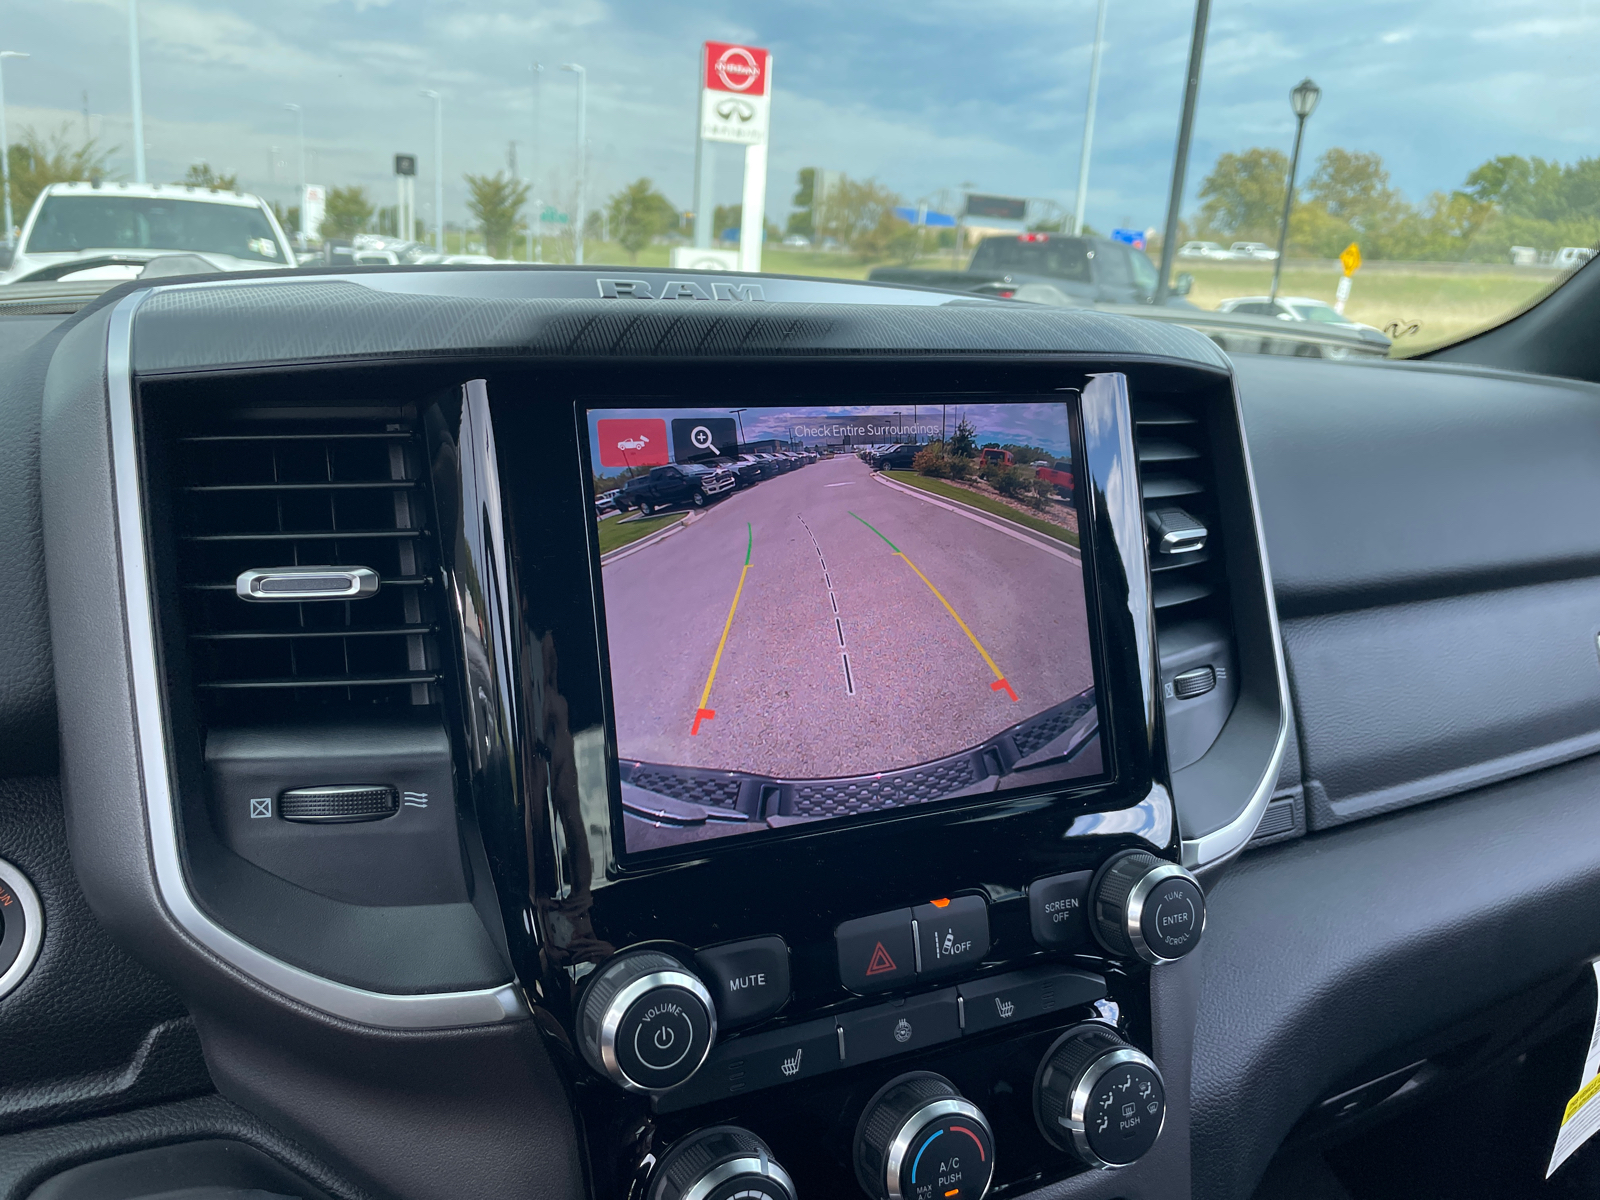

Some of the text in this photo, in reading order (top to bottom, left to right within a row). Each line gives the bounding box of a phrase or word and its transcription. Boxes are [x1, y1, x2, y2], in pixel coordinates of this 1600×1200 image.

[596, 279, 766, 301] RAM
[795, 422, 940, 437] Check Entire Surroundings
[1164, 891, 1183, 902] TUNE
[1045, 898, 1079, 913] SCREEN
[1053, 912, 1070, 923] OFF
[1162, 912, 1188, 926] ENTER
[1165, 932, 1190, 946] SCROLL
[954, 941, 972, 954] OFF
[729, 973, 766, 992] MUTE
[642, 1003, 682, 1023] VOLUME
[1120, 1116, 1140, 1130] PUSH
[939, 1157, 960, 1173] A/C
[938, 1172, 962, 1187] PUSH
[916, 1184, 932, 1194] MAX
